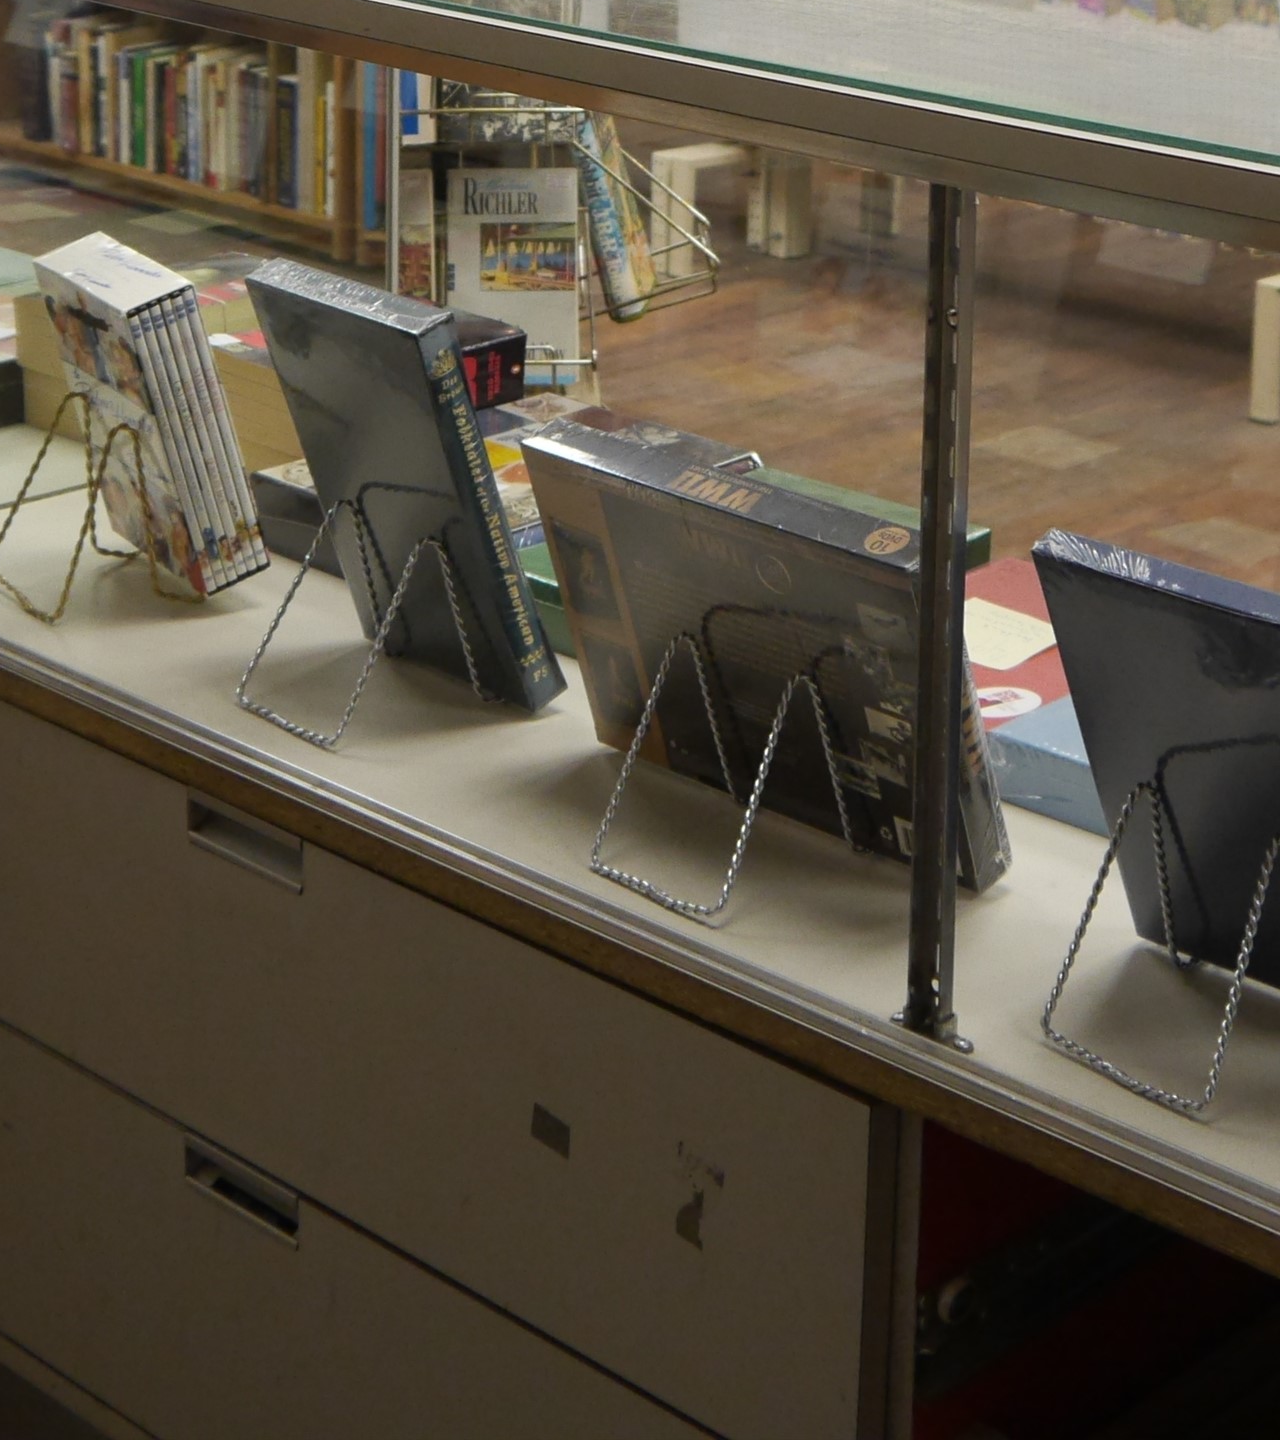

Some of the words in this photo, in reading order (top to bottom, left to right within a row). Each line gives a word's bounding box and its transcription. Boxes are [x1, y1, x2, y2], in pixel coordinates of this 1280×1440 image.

[463, 176, 539, 216] RICHLER
[667, 469, 764, 514] WWII
[450, 403, 486, 485] Folktales
[484, 511, 513, 571] Native
[502, 569, 537, 648] American
[869, 539, 890, 553] 10
